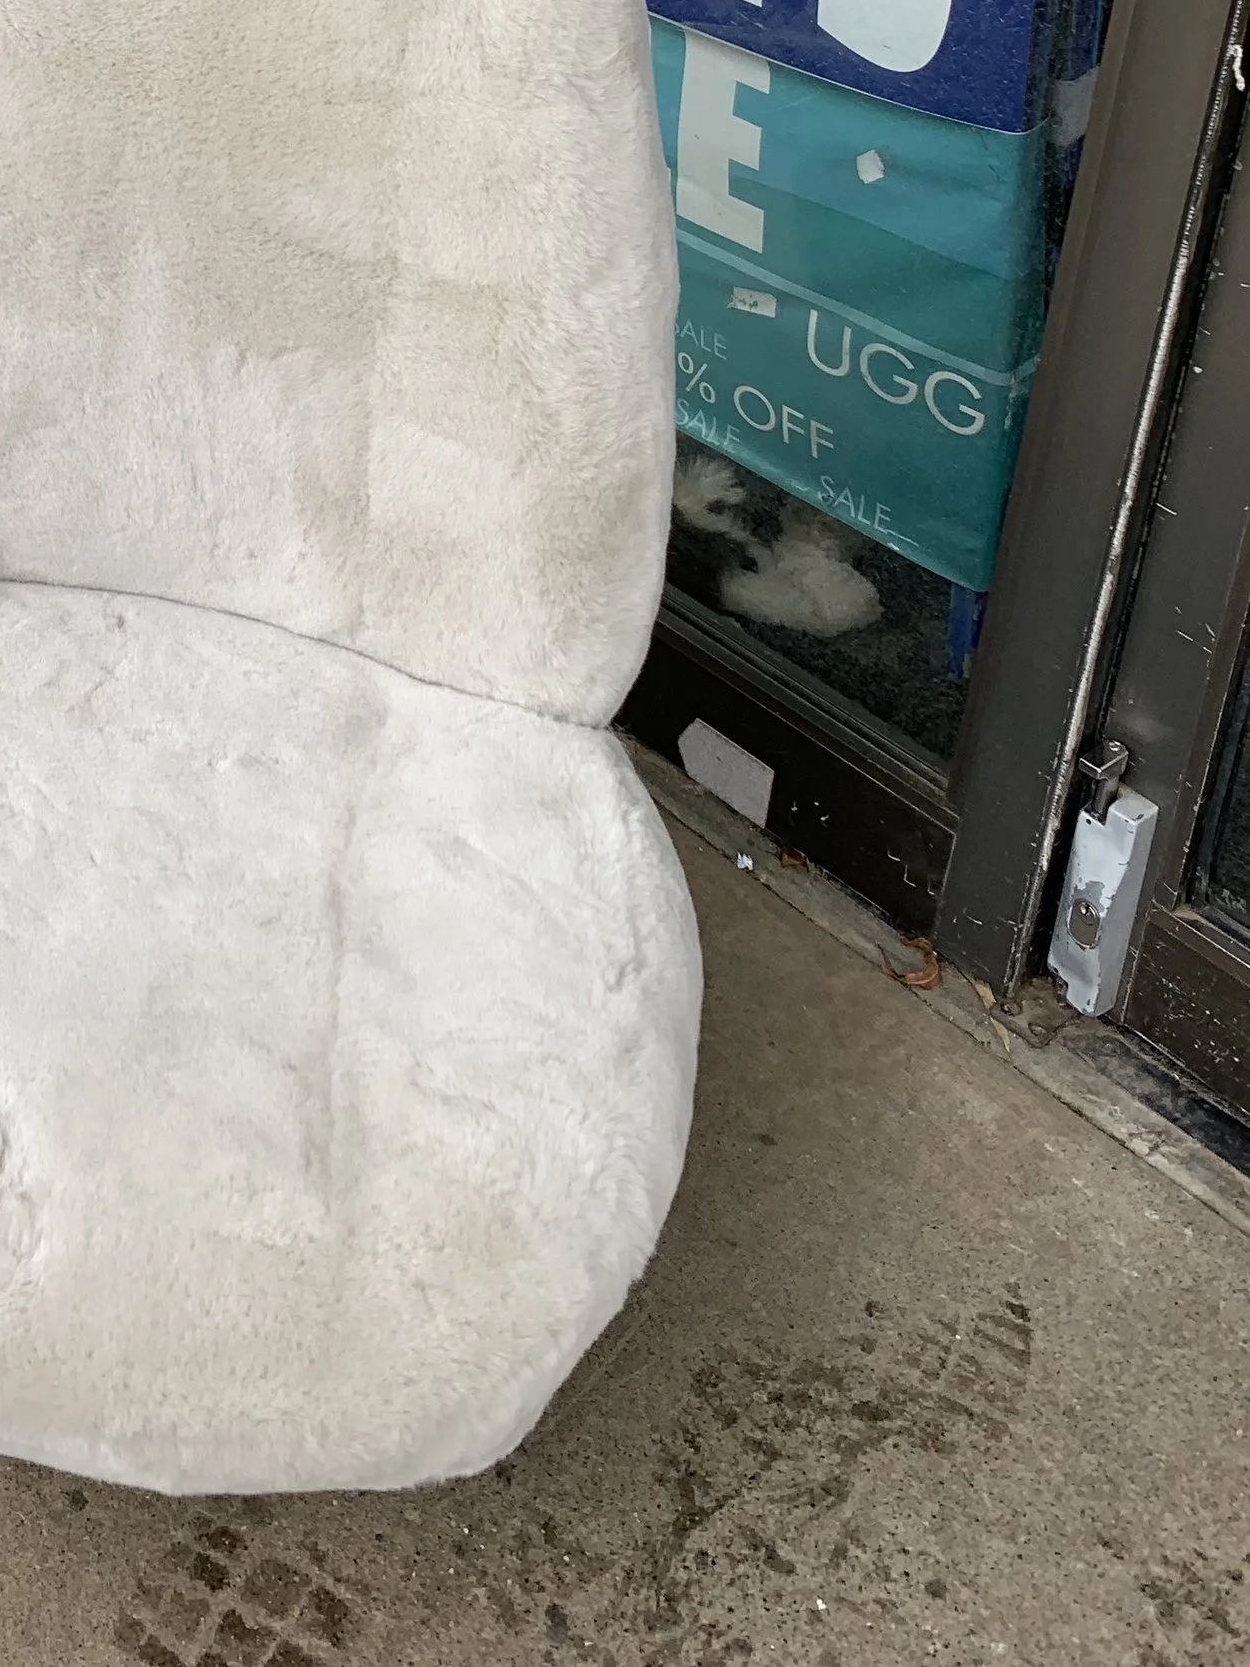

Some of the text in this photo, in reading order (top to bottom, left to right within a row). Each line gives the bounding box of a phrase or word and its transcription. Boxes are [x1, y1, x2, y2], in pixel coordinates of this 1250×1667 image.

[674, 320, 727, 360] ALE
[807, 309, 985, 436] UGG
[676, 398, 741, 447] SALE
[733, 385, 834, 459] OFF
[817, 475, 892, 533] SALE
